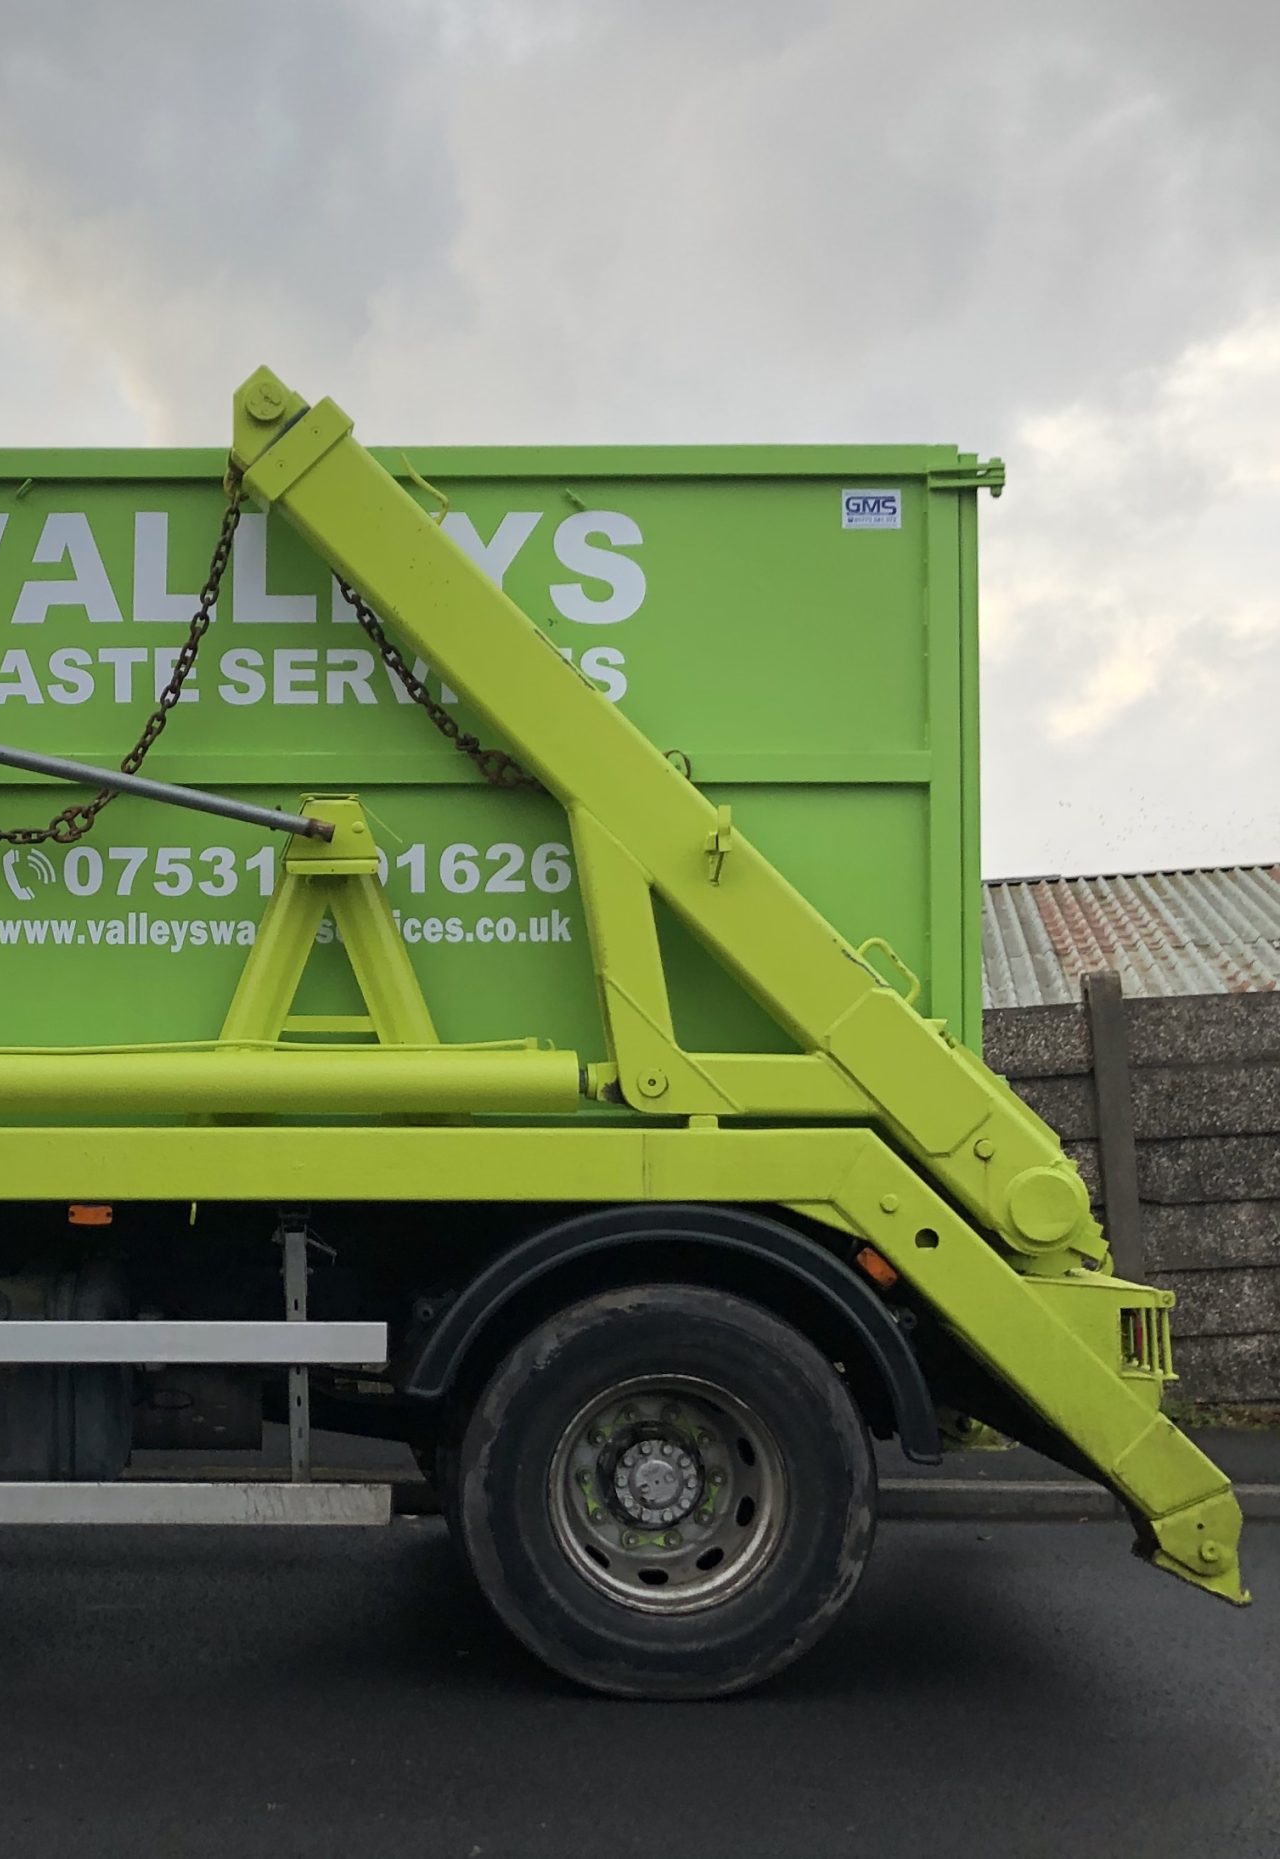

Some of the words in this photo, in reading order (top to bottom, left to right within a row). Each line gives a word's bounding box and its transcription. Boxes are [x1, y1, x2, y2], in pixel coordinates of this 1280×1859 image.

[846, 495, 897, 516] GMS
[218, 646, 627, 705] SERVS
[63, 845, 276, 896] 07531
